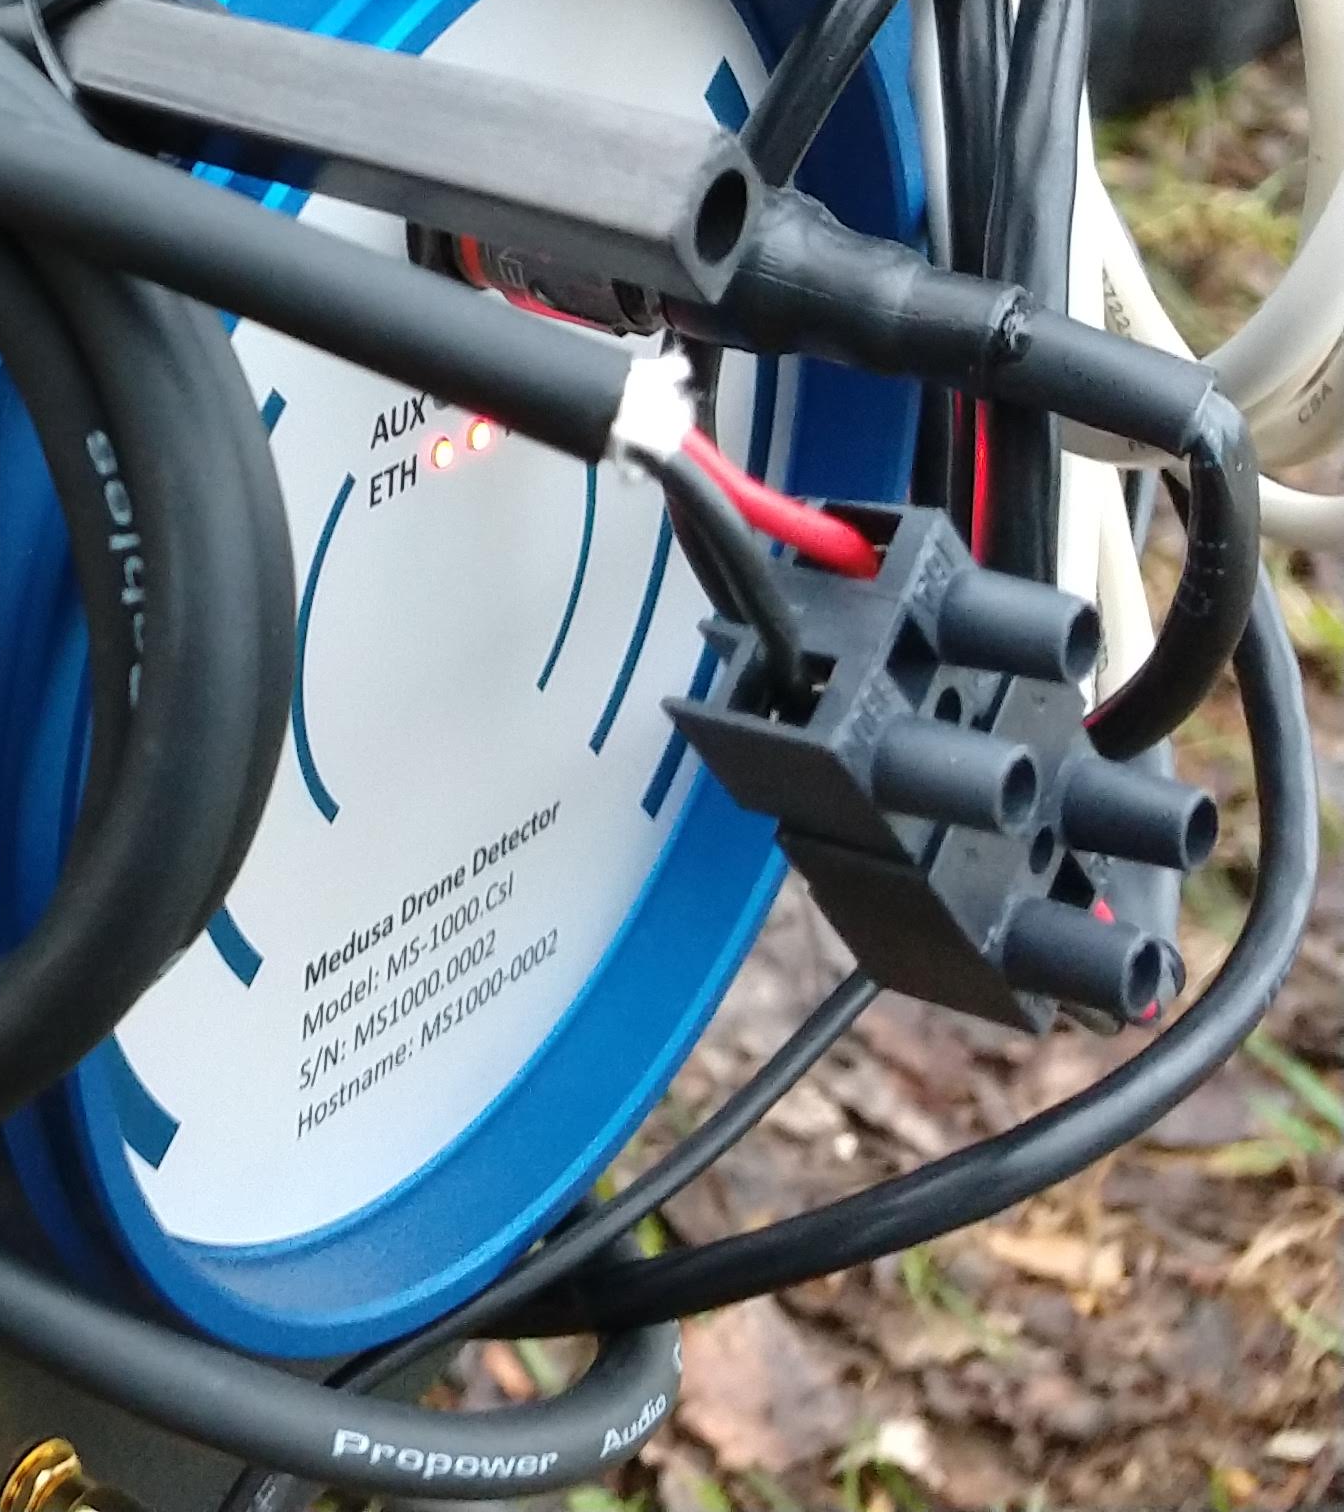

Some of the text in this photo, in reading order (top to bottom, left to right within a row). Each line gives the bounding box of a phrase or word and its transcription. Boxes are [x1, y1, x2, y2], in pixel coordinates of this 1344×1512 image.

[370, 390, 428, 450] AUX
[369, 453, 418, 509] ETH
[303, 800, 562, 992] Medusa Drone Detector
[296, 926, 560, 1141] Hostname: MS1000-0002
[298, 928, 497, 1090] S/N: MS1000.0002
[301, 968, 380, 1042] Model:
[331, 1390, 669, 1481] Propower Audio
